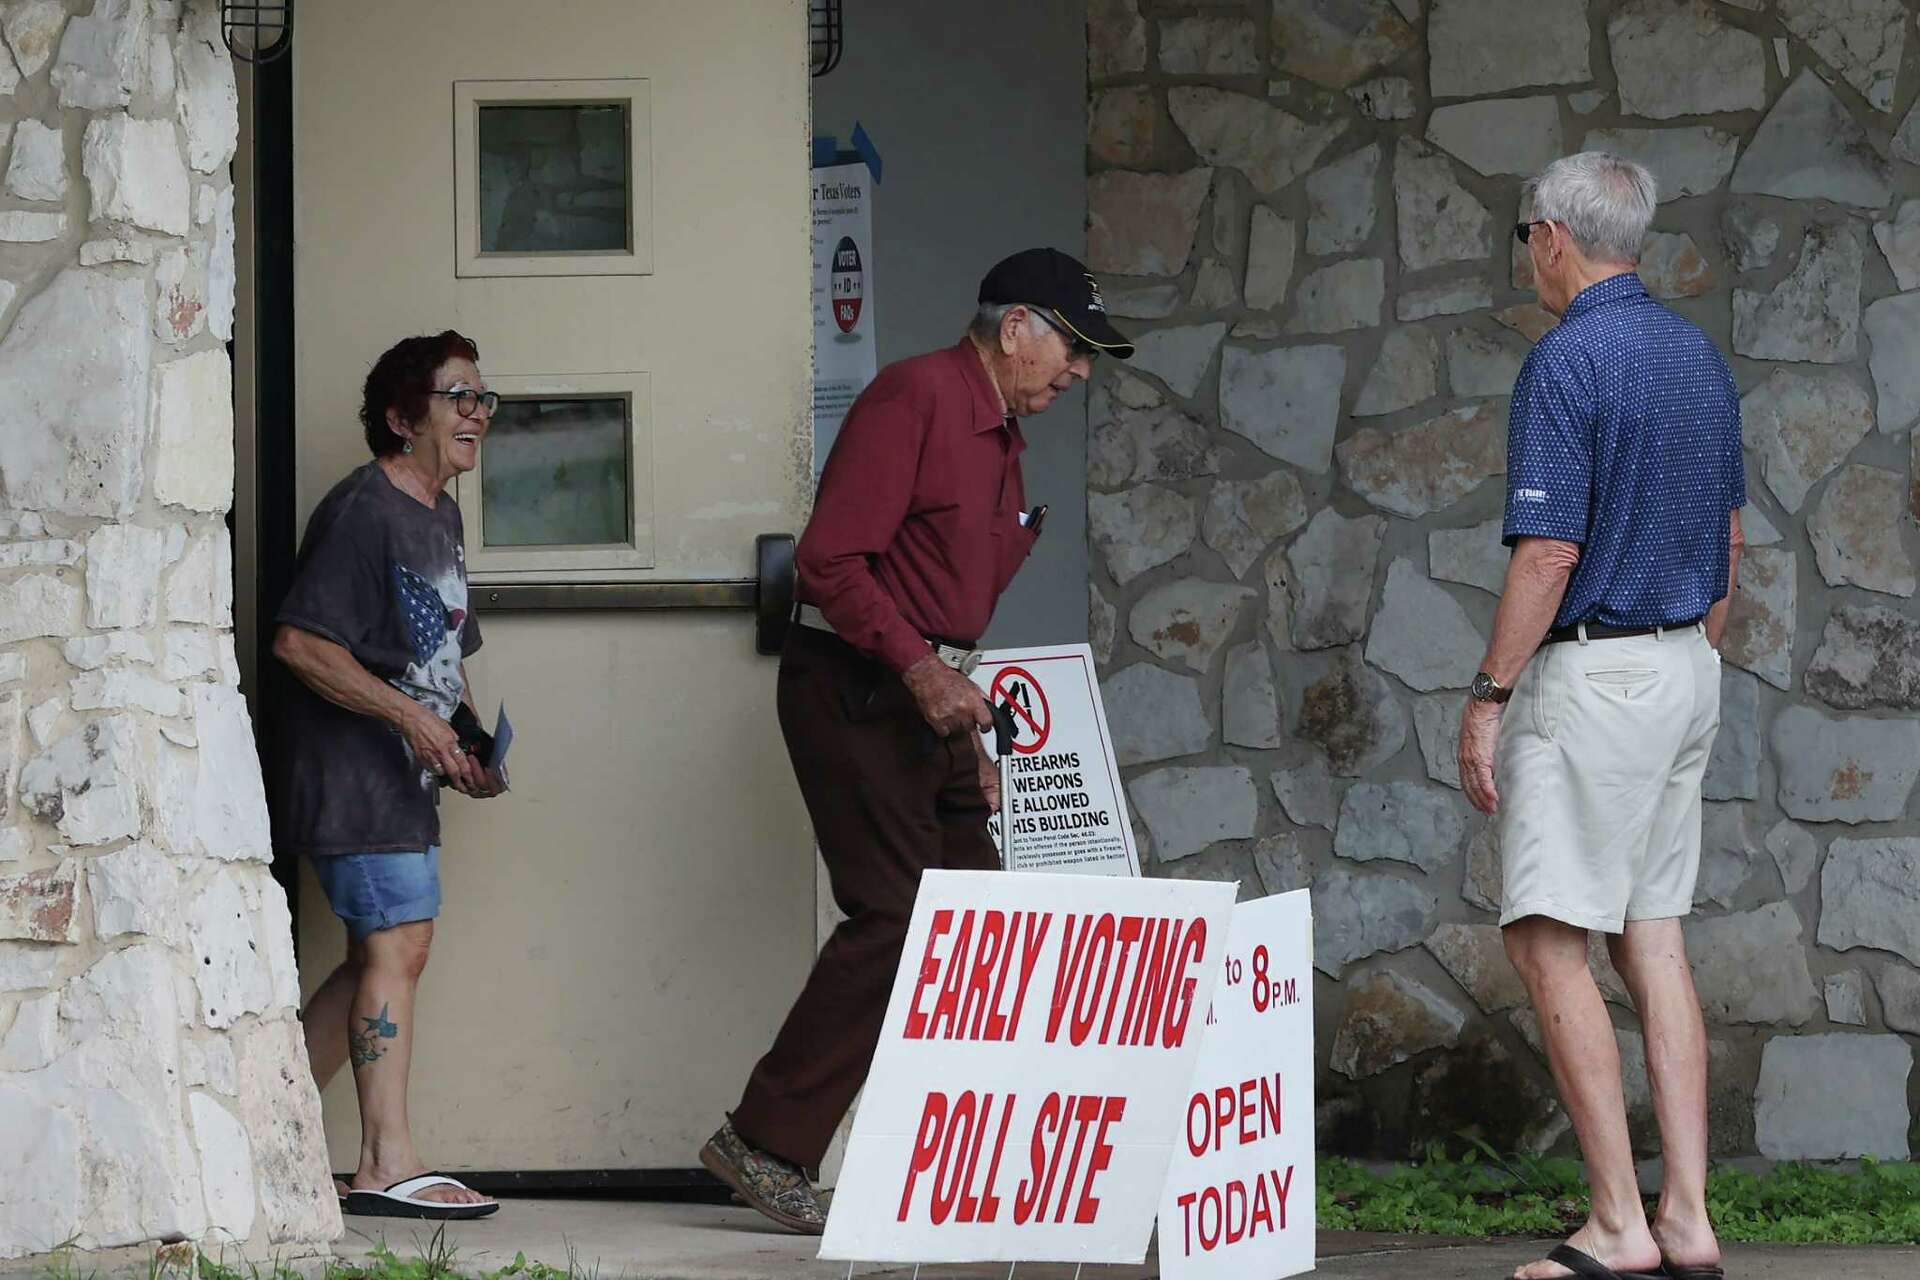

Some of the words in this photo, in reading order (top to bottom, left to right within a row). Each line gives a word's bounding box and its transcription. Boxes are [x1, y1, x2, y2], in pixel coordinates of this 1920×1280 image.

[837, 251, 857, 266] VOTER
[844, 278, 851, 293] ID
[1013, 773, 1083, 793] WEAPONS
[1024, 793, 1089, 813] ALLOWED
[1013, 817, 1036, 834] HIS
[1040, 811, 1109, 831] BUILDING
[902, 909, 1053, 1041] EARLY
[1044, 912, 1207, 1050] VOTING
[1225, 954, 1242, 986] to
[1186, 1072, 1281, 1158] OPEN
[896, 1090, 1016, 1226] POLL
[1012, 1091, 1127, 1226] SITE
[1177, 1165, 1294, 1257] TODAY
